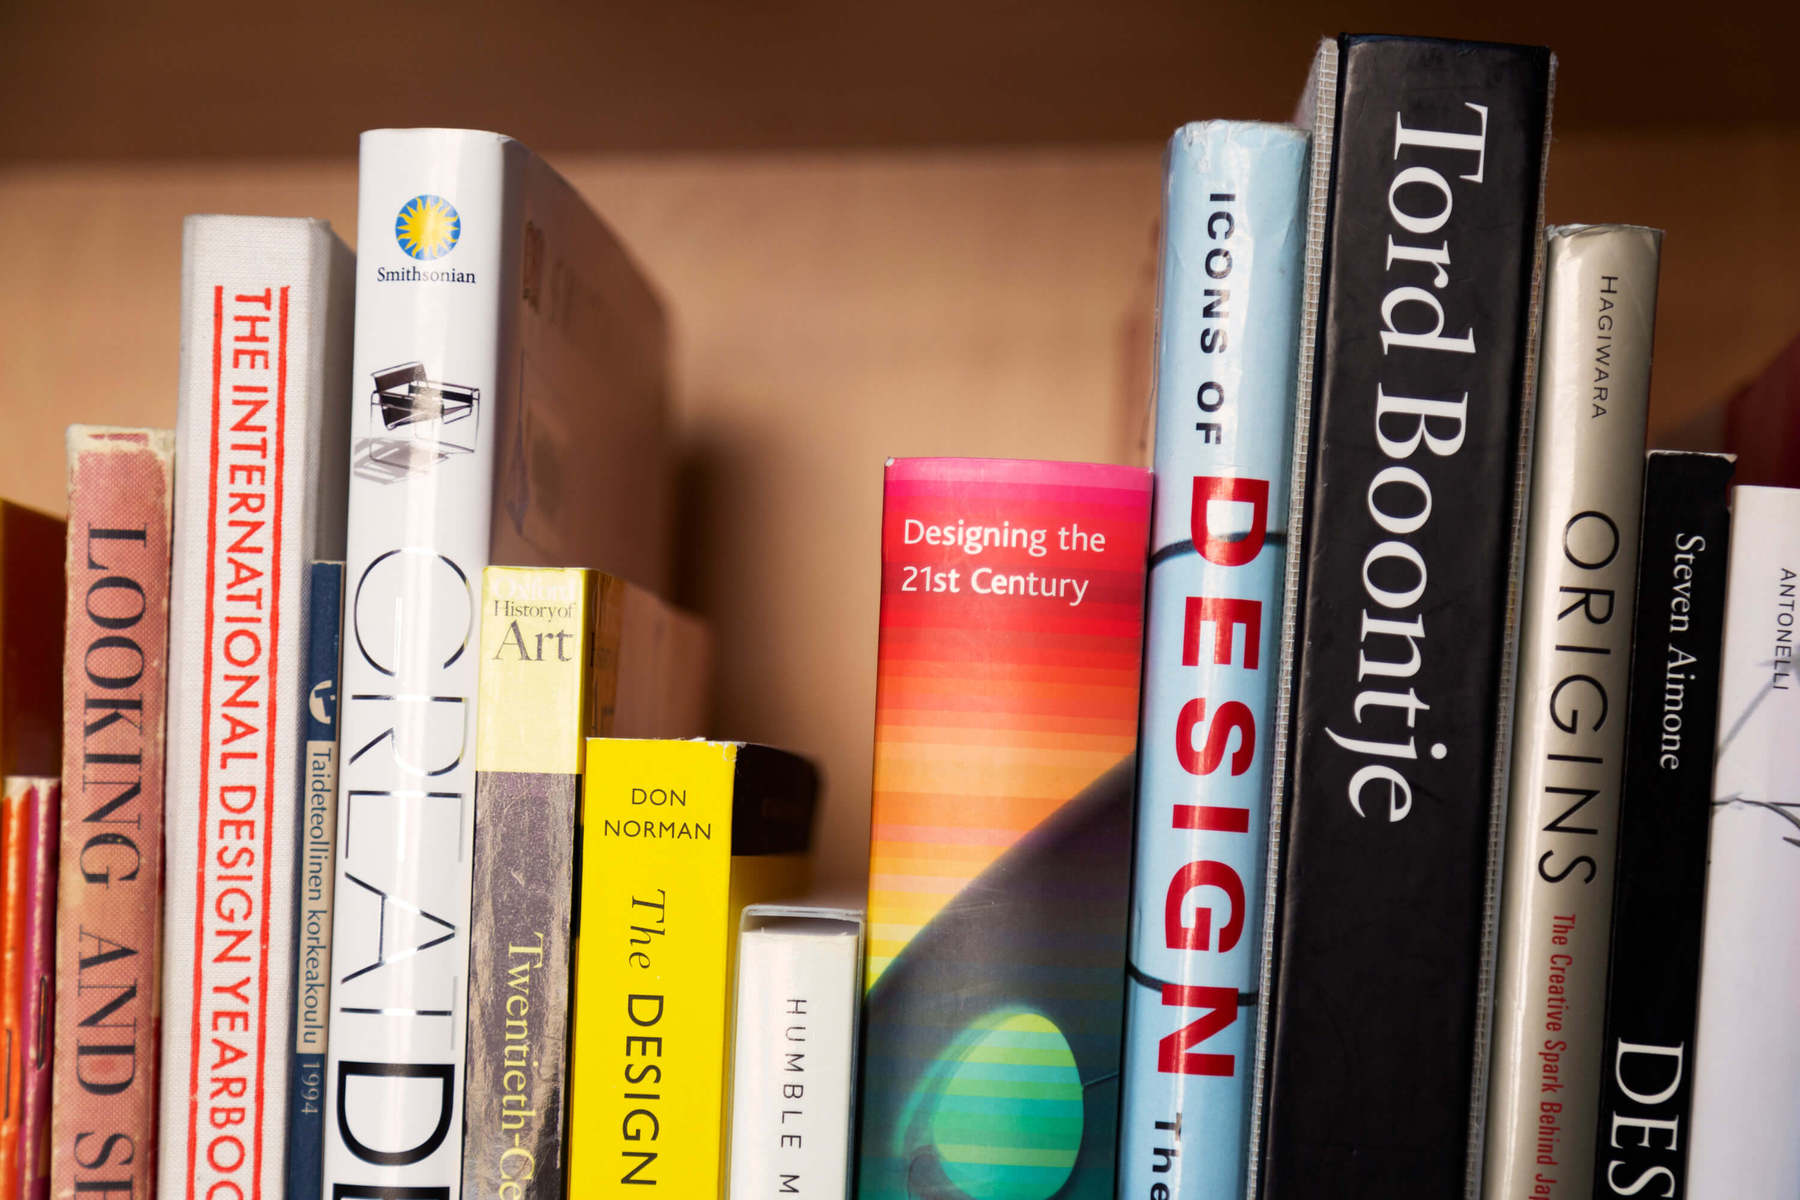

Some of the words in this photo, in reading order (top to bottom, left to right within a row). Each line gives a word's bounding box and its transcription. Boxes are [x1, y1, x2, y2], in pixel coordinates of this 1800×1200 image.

[376, 266, 477, 285] Smithsonian
[1200, 192, 1236, 355] ICONS
[1379, 102, 1489, 356] Tord
[232, 287, 272, 370] THE
[1591, 275, 1619, 420] HAGIWARA
[1195, 380, 1225, 446] OF
[220, 385, 269, 770] INTERNATIONAL
[901, 566, 960, 593] 21st
[971, 567, 1089, 607] Century
[903, 519, 1047, 557] Designing
[1058, 524, 1106, 552] the
[1669, 533, 1706, 633] Steven
[491, 619, 574, 662] Art
[494, 600, 556, 622] History
[557, 602, 577, 617] of
[1325, 382, 1468, 822] Boontje
[1772, 567, 1798, 690] ANTONELLI
[80, 523, 148, 889] LOOKING
[1537, 510, 1620, 885] ORIGINS
[1659, 643, 1697, 771] Aimone
[308, 748, 332, 901] Taideteollinen
[631, 788, 686, 806] DON
[1157, 476, 1270, 1077] DESIGN
[212, 785, 257, 963] DESIGN
[604, 819, 711, 840] NORMAN
[303, 909, 328, 1044] korkeakoulu
[628, 889, 666, 969] The
[1551, 914, 1577, 946] The
[75, 924, 139, 1096] AND
[1545, 953, 1573, 1033] Creative
[301, 1061, 321, 1115] 1994
[620, 993, 664, 1186] DESIGN
[781, 998, 808, 1148] HUMBLE
[1538, 1039, 1567, 1093] Spark
[332, 1060, 455, 1200] D
[1150, 1112, 1182, 1200] The
[1535, 1102, 1563, 1167] Behind
[1607, 1037, 1685, 1199] DES
[778, 1174, 800, 1193] M
[1529, 1173, 1557, 1200] Ja
